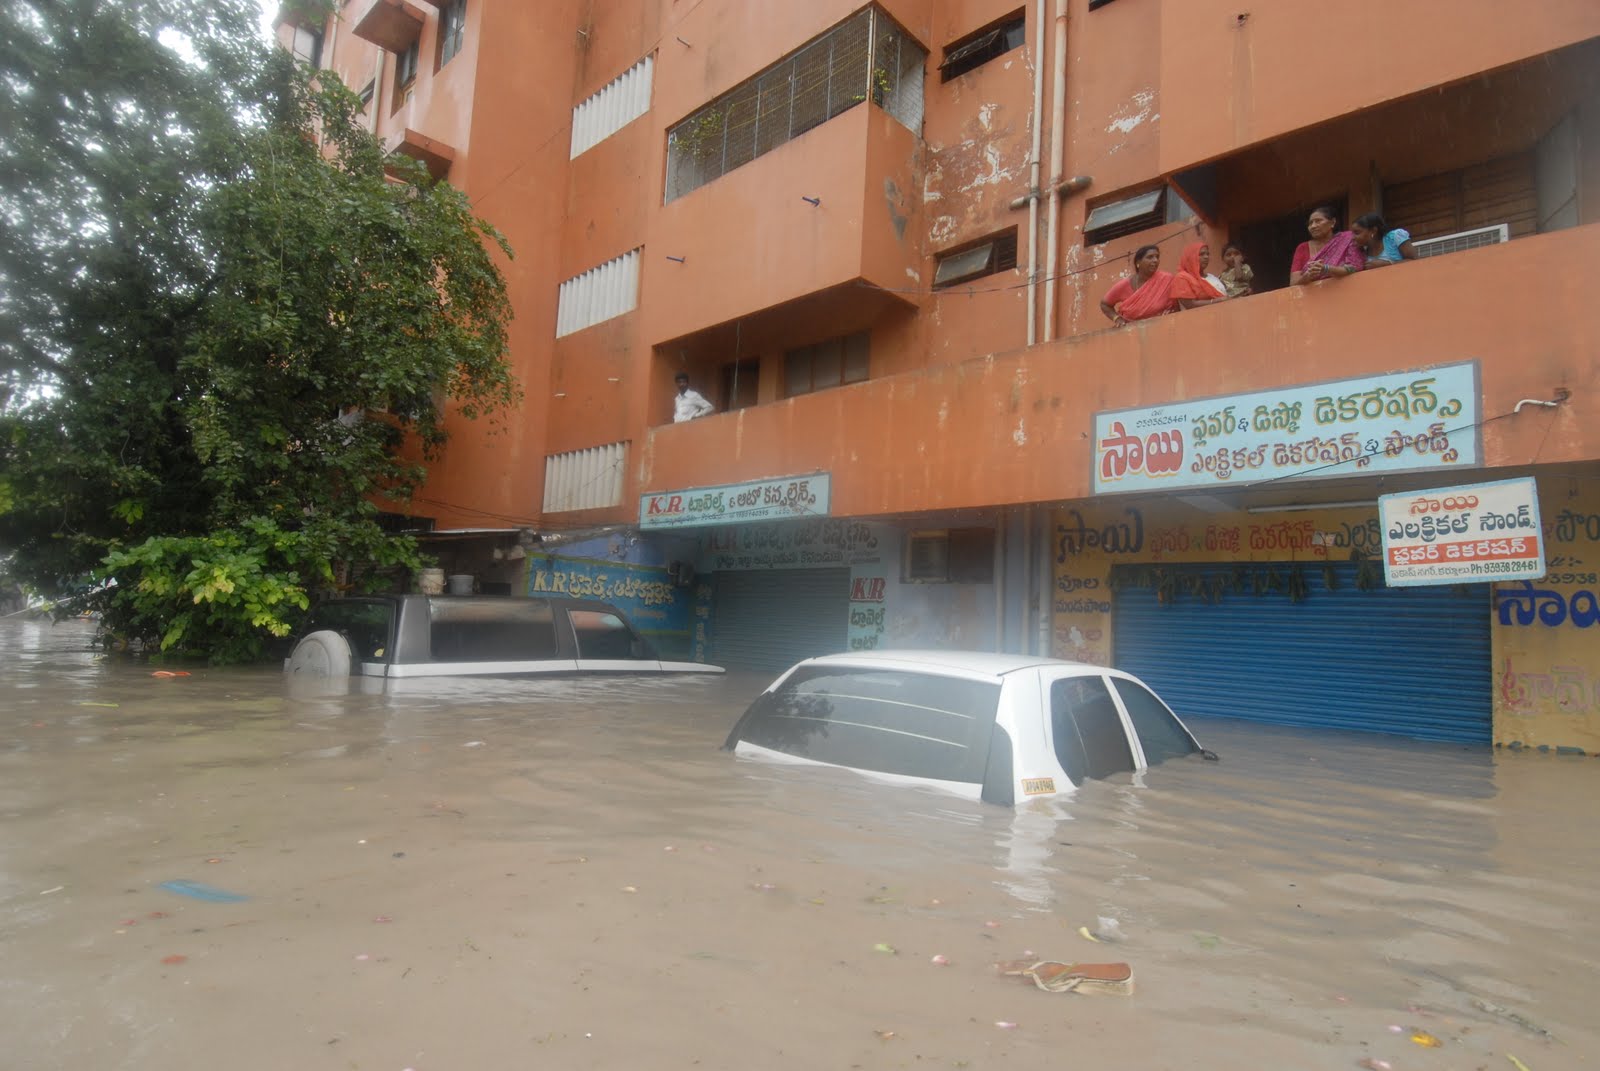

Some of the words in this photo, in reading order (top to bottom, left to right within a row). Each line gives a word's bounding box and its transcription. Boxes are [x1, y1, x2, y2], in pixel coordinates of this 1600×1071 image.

[1253, 401, 1302, 433] డిస్కో
[1314, 378, 1462, 425] డెకరేషన్స్
[1100, 421, 1184, 479] సాయి
[1273, 431, 1370, 468] డెకరేషన్స్
[1410, 495, 1479, 516] సాయి
